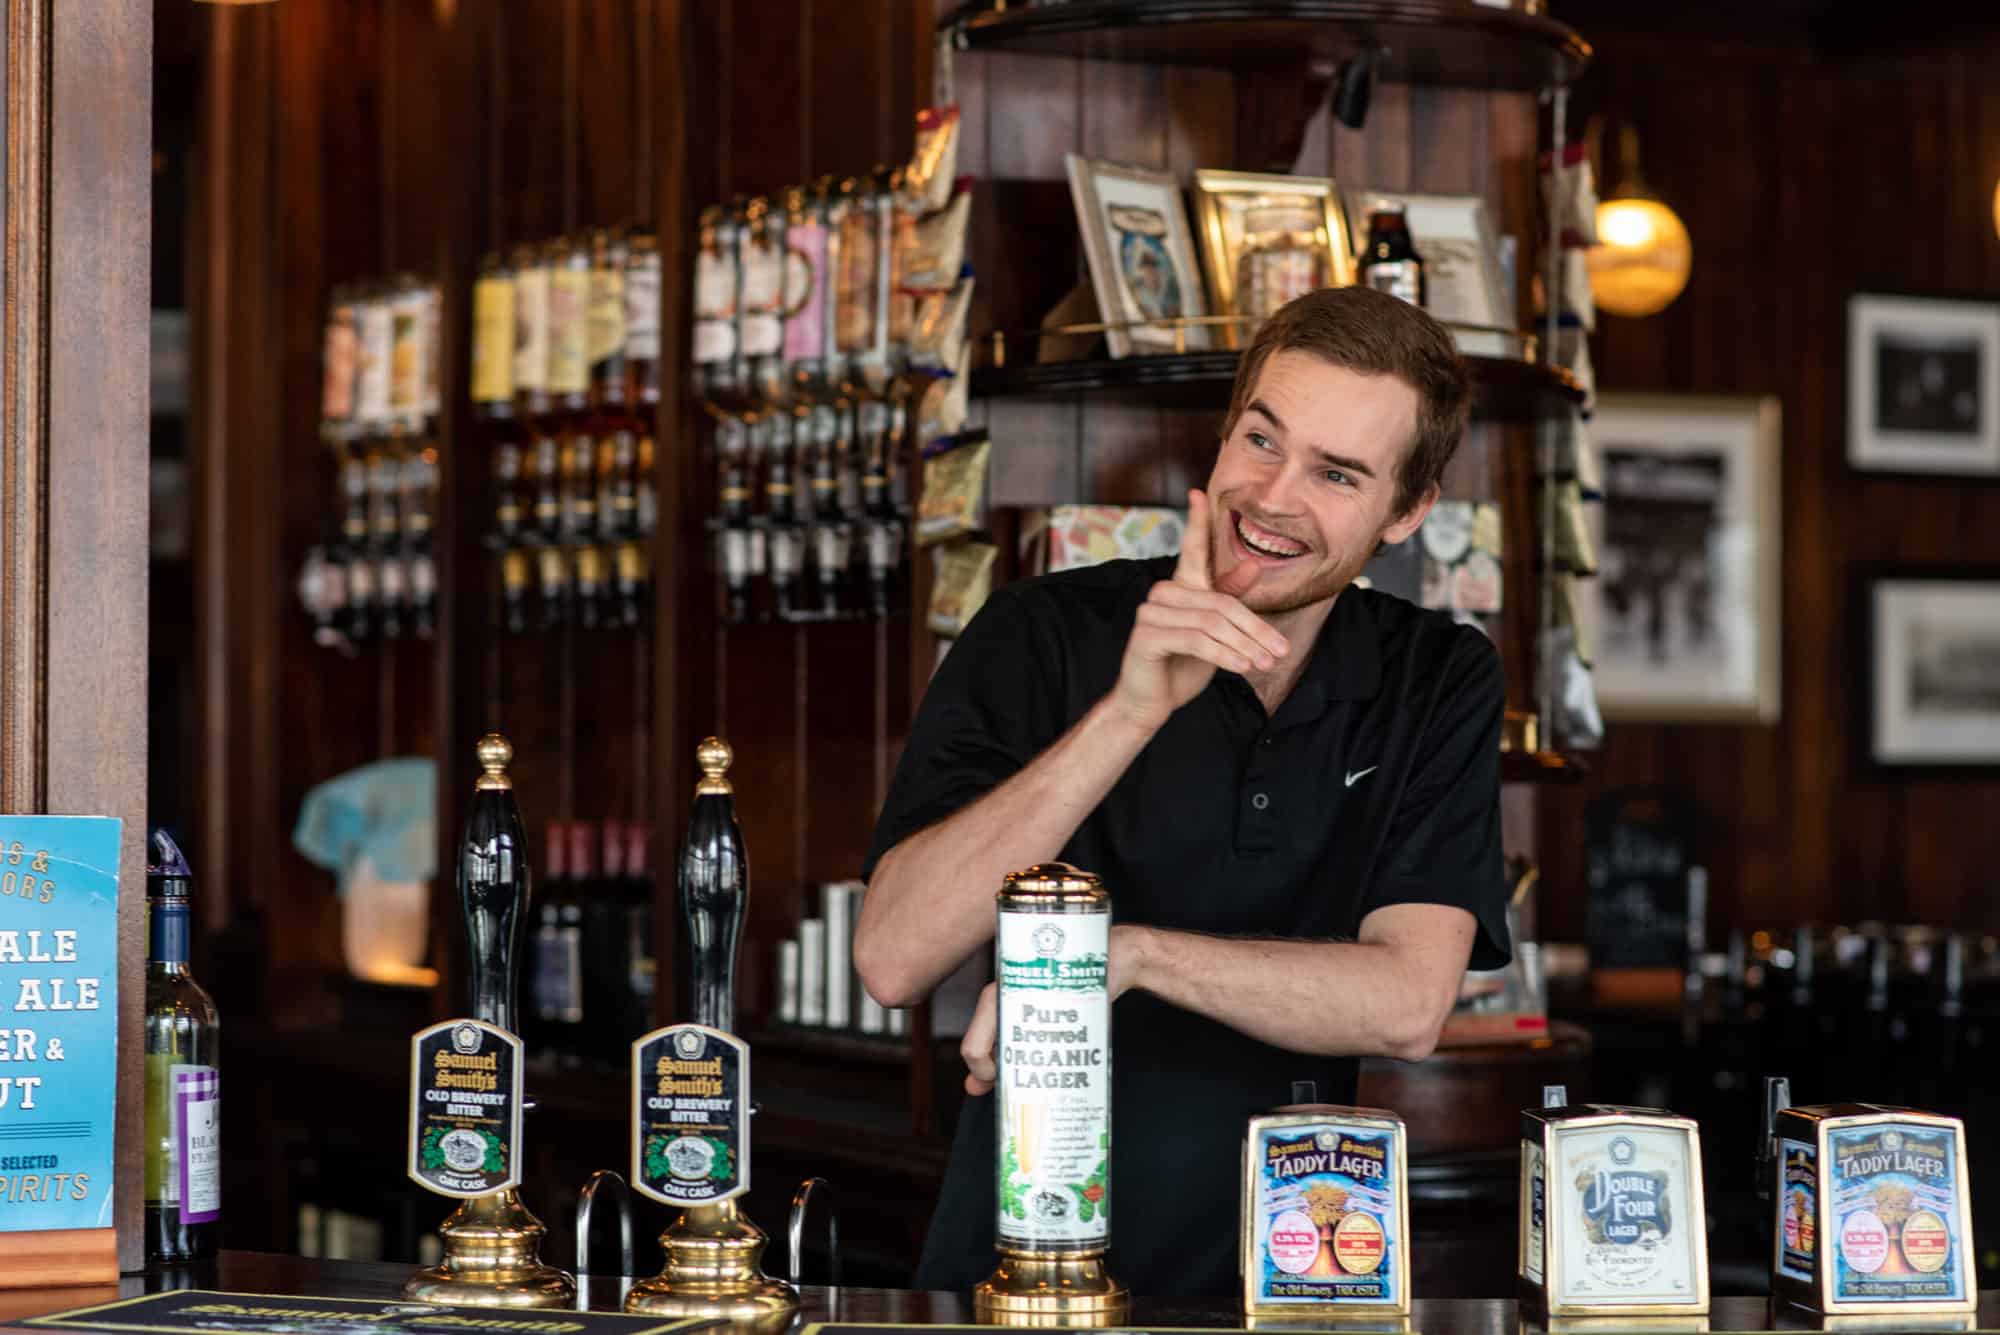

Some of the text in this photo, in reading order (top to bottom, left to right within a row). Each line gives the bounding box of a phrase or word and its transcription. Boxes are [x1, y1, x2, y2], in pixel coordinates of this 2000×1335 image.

[0, 839, 49, 873] S &
[14, 978, 100, 1011] ALE
[1022, 1003, 1079, 1024] Pure
[1012, 1025, 1089, 1043] Brewed
[45, 1037, 65, 1060] &
[1003, 1046, 1102, 1067] ORGANIC
[434, 1049, 497, 1070] Samuel
[656, 1056, 723, 1076] Samuel
[435, 1069, 497, 1092] Smith's
[657, 1075, 723, 1098] Smith's
[1013, 1067, 1091, 1089] LAGER
[425, 1090, 506, 1106] OLD BREWERY
[647, 1097, 733, 1111] OLD BREWERY
[446, 1103, 484, 1116] BITTER
[670, 1110, 709, 1123] BITTER
[1, 1155, 58, 1170] SELECTED
[1268, 1151, 1384, 1179] TADDY LAGER
[1838, 1154, 1892, 1178] TADDY
[1893, 1151, 1945, 1178] LAGER
[439, 1175, 488, 1190] OAK CASK
[664, 1183, 716, 1198] OAK CASK
[1587, 1168, 1656, 1213] DOUBLE
[1612, 1194, 1657, 1222] FOUR
[1608, 1224, 1639, 1237] LAGER
